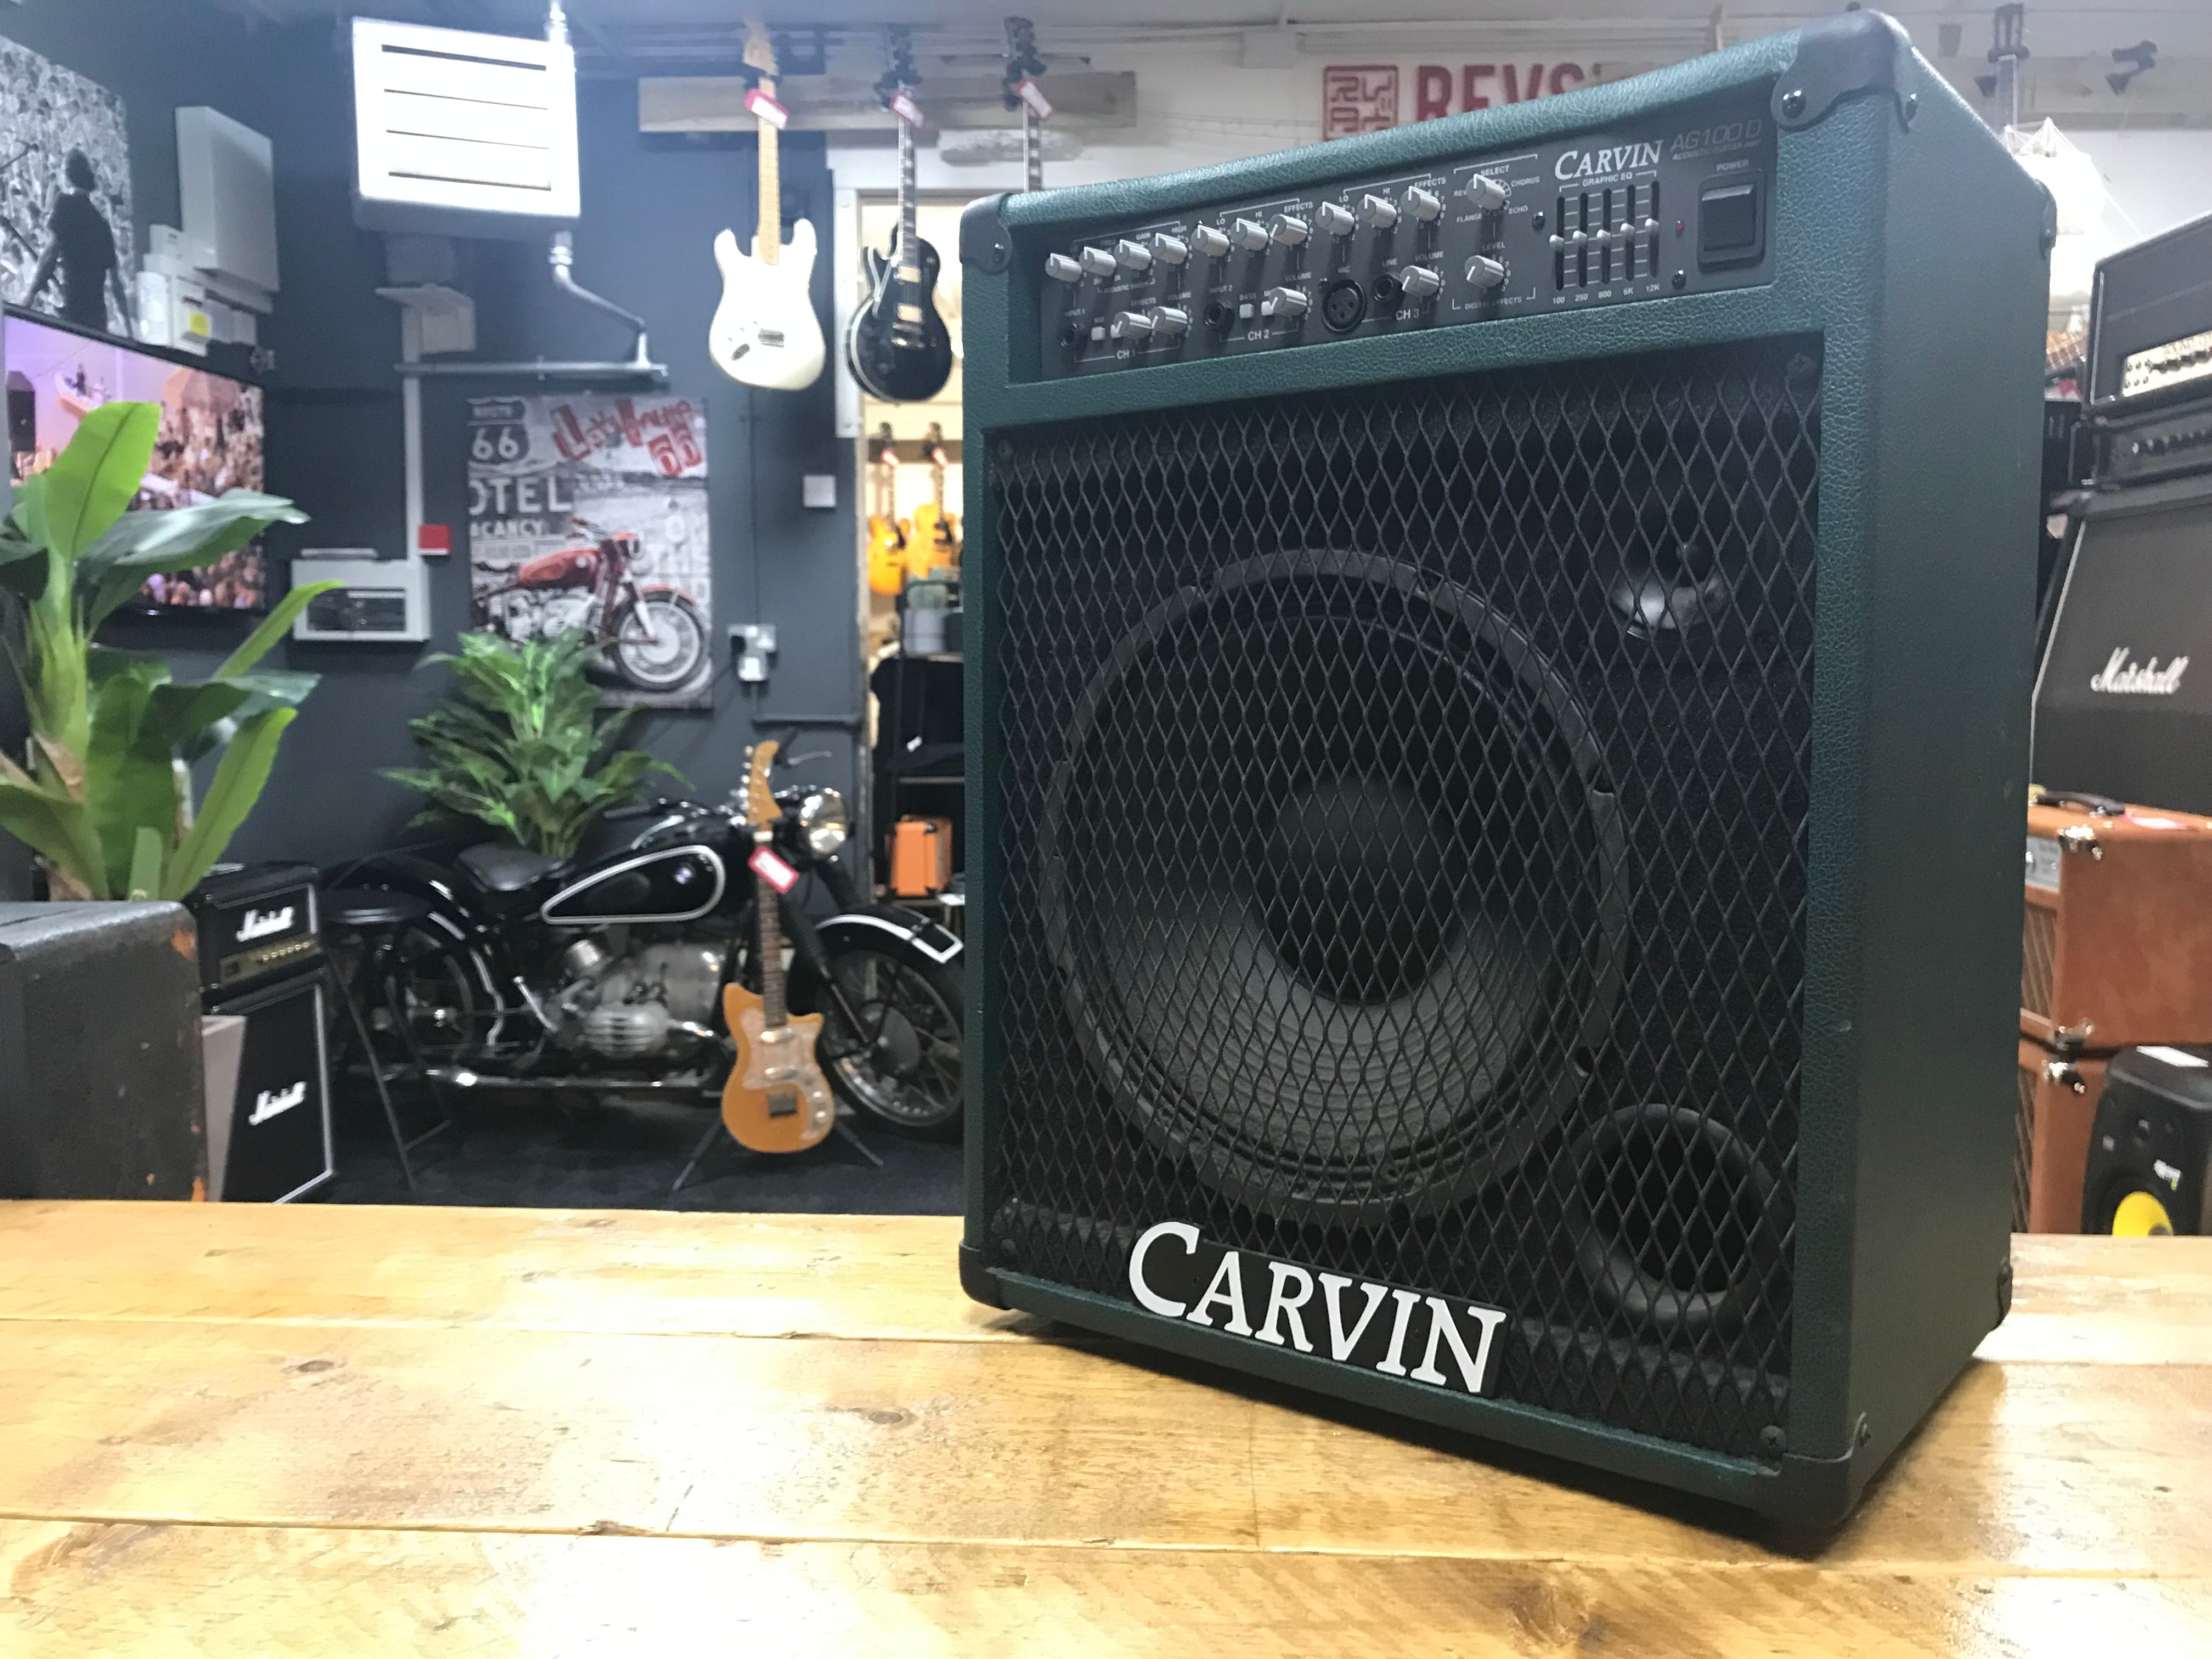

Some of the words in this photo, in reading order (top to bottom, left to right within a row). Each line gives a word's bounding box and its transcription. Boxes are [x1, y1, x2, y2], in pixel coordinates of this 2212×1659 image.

[1555, 140, 1663, 180] CARVIN
[1717, 159, 1749, 171] POWER
[1481, 165, 1510, 176] SELECT
[1414, 177, 1446, 188] EFFECTS
[1511, 176, 1540, 187] CHORUS
[1583, 174, 1618, 187] GRAPHIC
[1621, 172, 1633, 180] EQ
[1284, 201, 1313, 213] EFFECTS
[1509, 205, 1528, 215] ECHO
[1382, 258, 1398, 267] LINE
[1414, 251, 1444, 262] VOLUME
[1575, 294, 1588, 302] 250
[1646, 284, 1660, 292] 12K
[1395, 309, 1410, 321] CH
[1413, 308, 1419, 319] 3
[1248, 330, 1261, 341] CH
[1116, 349, 1130, 360] CH
[472, 426, 519, 460] 66
[2090, 647, 2189, 694] Marshall
[1129, 1221, 1506, 1393] CARVIN
